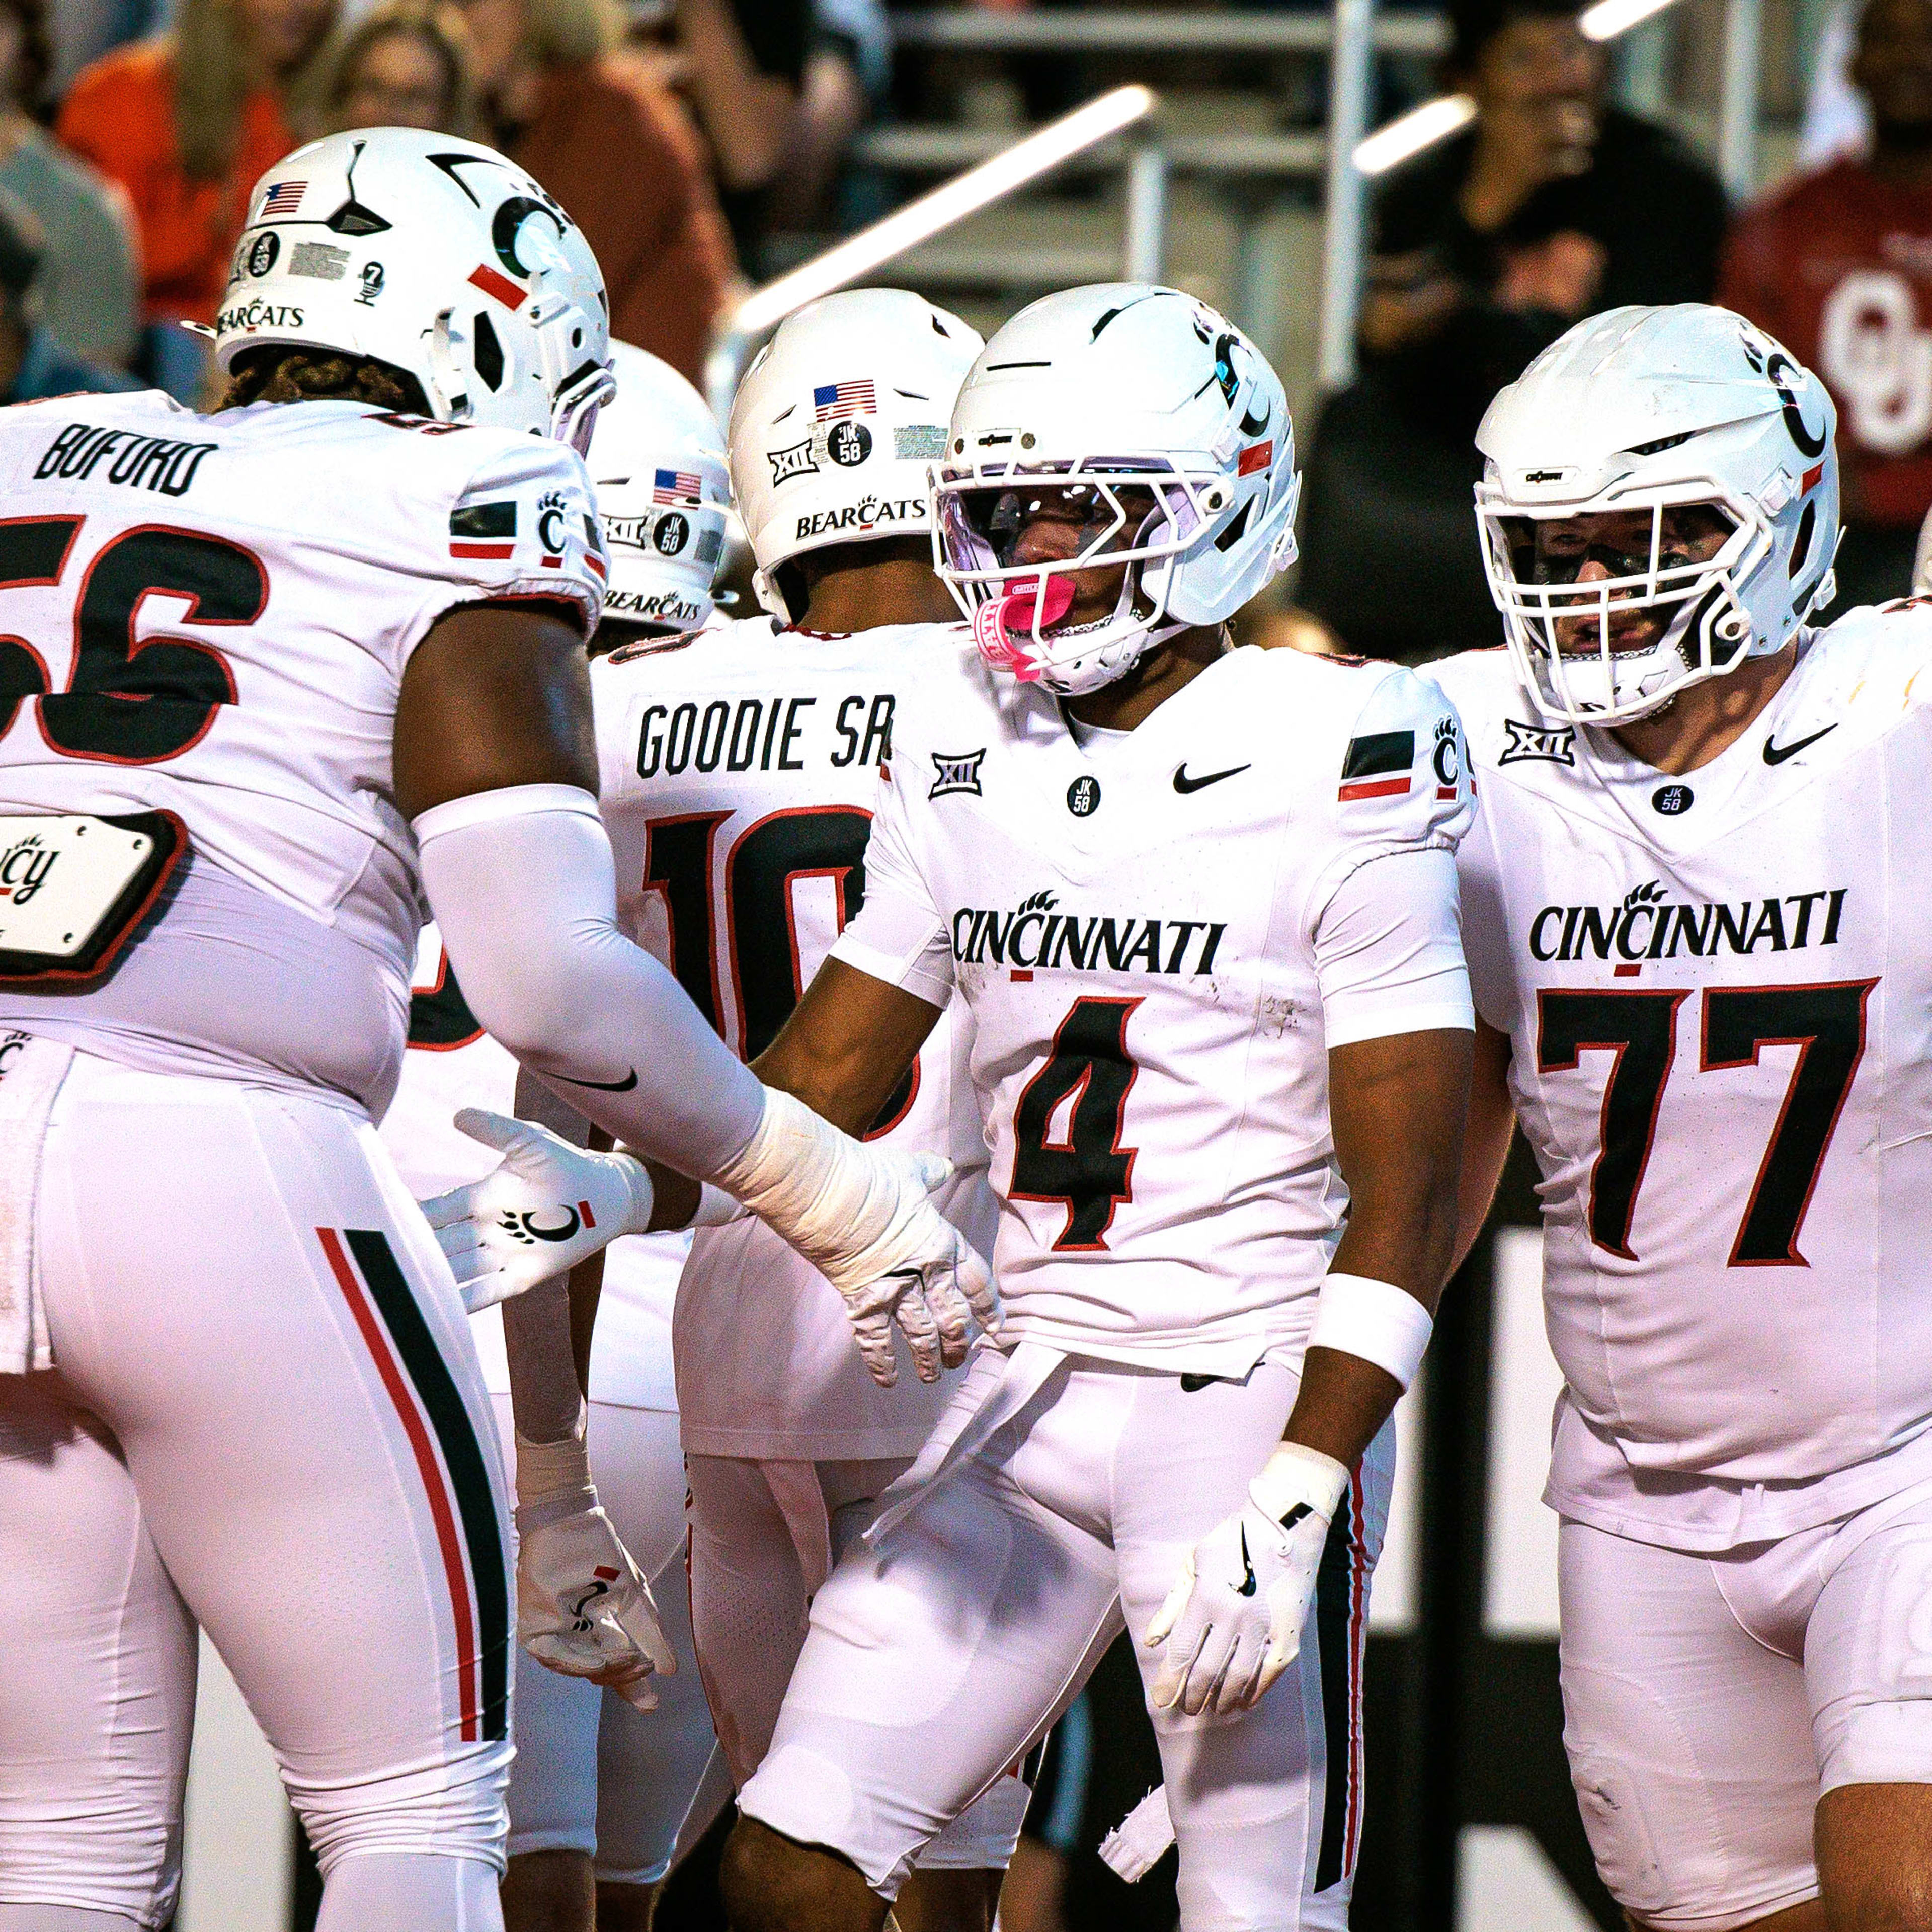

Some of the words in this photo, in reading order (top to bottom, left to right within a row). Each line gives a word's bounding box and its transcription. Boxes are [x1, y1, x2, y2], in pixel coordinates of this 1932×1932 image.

[838, 425, 858, 443] JK
[839, 443, 861, 463] 58
[33, 423, 219, 497] BUFORD
[665, 516, 682, 534] JK
[796, 499, 926, 541] BEARCATS
[661, 533, 679, 552] 58
[637, 697, 817, 779] GOODIE
[830, 694, 896, 767] SR
[1499, 718, 1576, 767] XII
[928, 748, 987, 802] XII
[1076, 779, 1092, 795] JK
[1665, 788, 1683, 797] JK
[1073, 795, 1090, 812] 58
[1662, 798, 1681, 810] 58
[953, 908, 1228, 975] CINCINNATI
[1529, 888, 1849, 962] CINCINNATI
[1007, 996, 1147, 1252] 4
[1536, 976, 1883, 1269] 77
